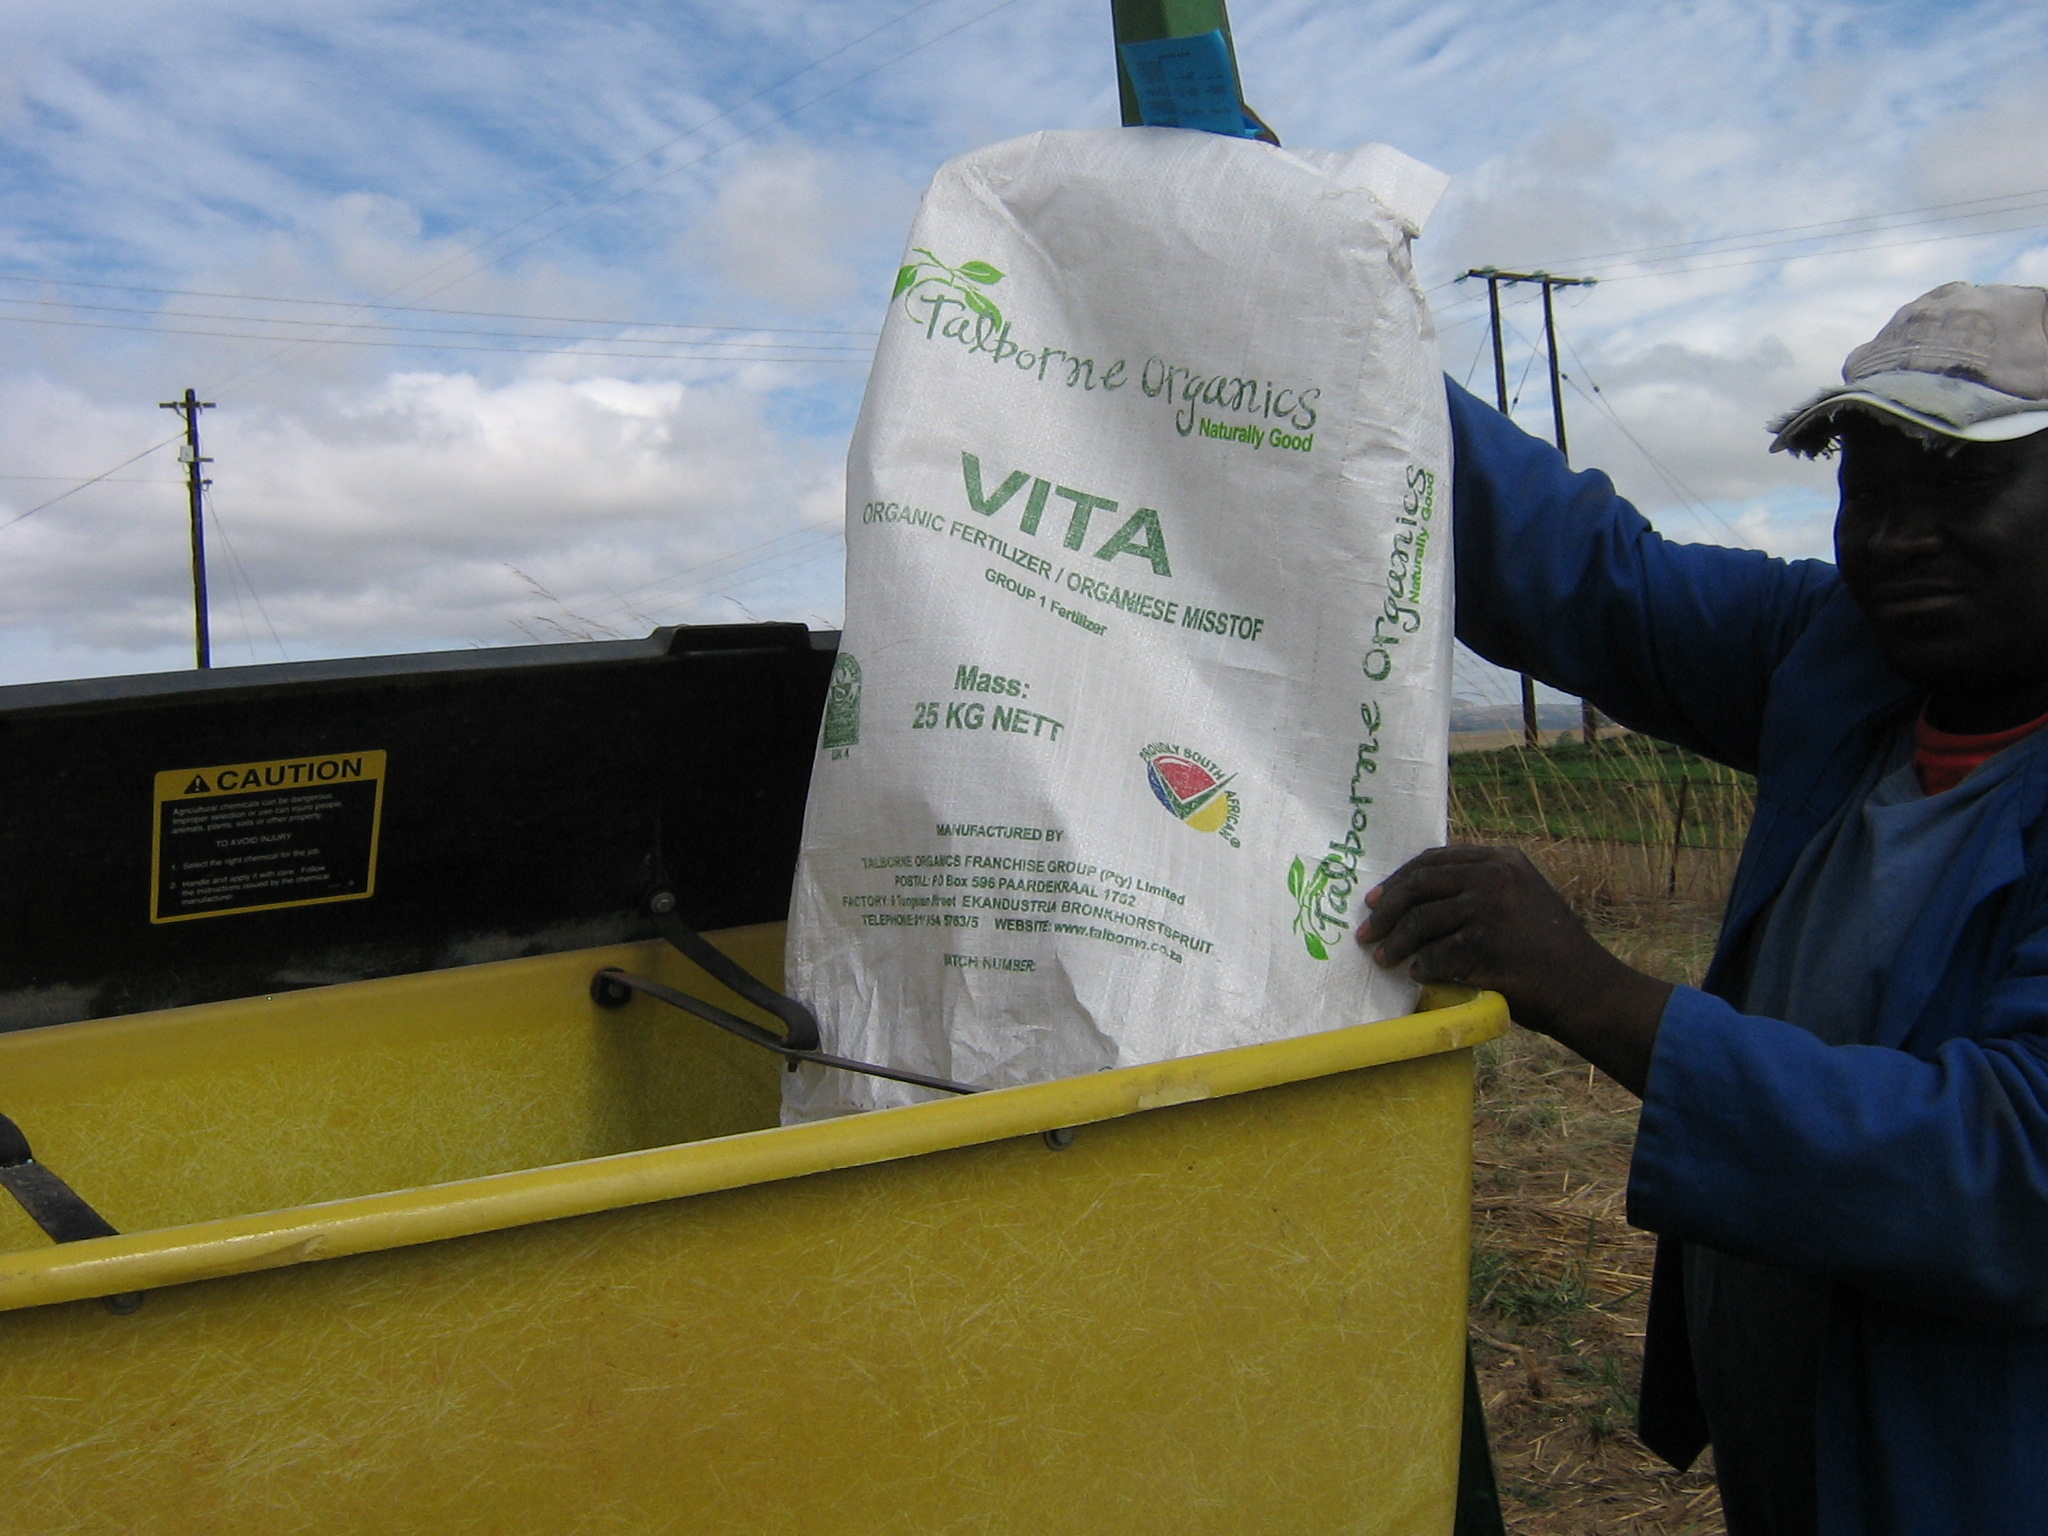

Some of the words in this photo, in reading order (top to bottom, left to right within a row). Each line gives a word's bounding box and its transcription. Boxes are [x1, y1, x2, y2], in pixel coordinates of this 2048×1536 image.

[920, 292, 1127, 391] Talborne
[1141, 353, 1322, 437] Organics
[1200, 416, 1265, 450] Naturally
[1269, 428, 1314, 454] Good
[961, 450, 1173, 578] VITA
[1408, 526, 1430, 604] Naturally
[1421, 472, 1435, 522] Good
[863, 502, 946, 532] ORGANIC
[949, 520, 1053, 581] FERTILIZER
[1181, 605, 1265, 641] MISSTOF
[1362, 464, 1427, 681] Organics
[985, 568, 1036, 600] GROUP
[1039, 596, 1046, 608] 1
[1050, 600, 1108, 637] Fertilizer
[954, 664, 1030, 699] Mass:
[912, 701, 940, 729] 25
[946, 701, 985, 730] KG
[992, 704, 1065, 742] NETT
[217, 758, 362, 791] CAUTION
[1139, 742, 1180, 763] PROUDLY
[1184, 748, 1226, 780] SOUTH
[172, 804, 218, 816] Agricultural
[219, 801, 260, 811] chemicals
[278, 796, 289, 804] be
[172, 815, 209, 825] Improper
[211, 812, 246, 821] selection
[258, 808, 273, 816] use
[275, 806, 290, 814] can
[255, 817, 264, 825] or
[266, 815, 288, 824] other
[216, 839, 229, 848] TO
[230, 836, 258, 847] AVOID
[260, 832, 293, 843] INJURY
[936, 824, 1042, 841] MANUFACTURED
[1045, 829, 1064, 842] BY
[182, 878, 210, 888] Handle
[212, 876, 228, 885] and
[229, 874, 251, 885] apply
[259, 870, 276, 878] with
[300, 865, 326, 874] Follow
[183, 860, 208, 870] Select
[209, 858, 223, 867] the
[224, 856, 242, 867] right
[243, 852, 279, 863] chemical
[280, 851, 290, 859] for
[293, 848, 306, 857] the
[182, 889, 195, 897] the
[196, 884, 241, 895] instructions
[243, 880, 269, 890] issued
[270, 878, 280, 888] by
[281, 876, 294, 885] the
[295, 873, 330, 883] chemical
[862, 856, 912, 869] TALBORNE
[964, 855, 1045, 873] FRANCHISE
[1048, 861, 1097, 876] GROUP
[1100, 869, 1133, 889] (Pty)
[1135, 879, 1186, 905] Limited
[946, 875, 968, 887] Box
[971, 876, 995, 889] 596
[999, 877, 1098, 898] PAARDEKRAAL
[962, 896, 1056, 913] EKANDUSTRIA
[1061, 900, 1214, 954] BRONKHORSTSPRUIT
[944, 954, 978, 968] ATCH
